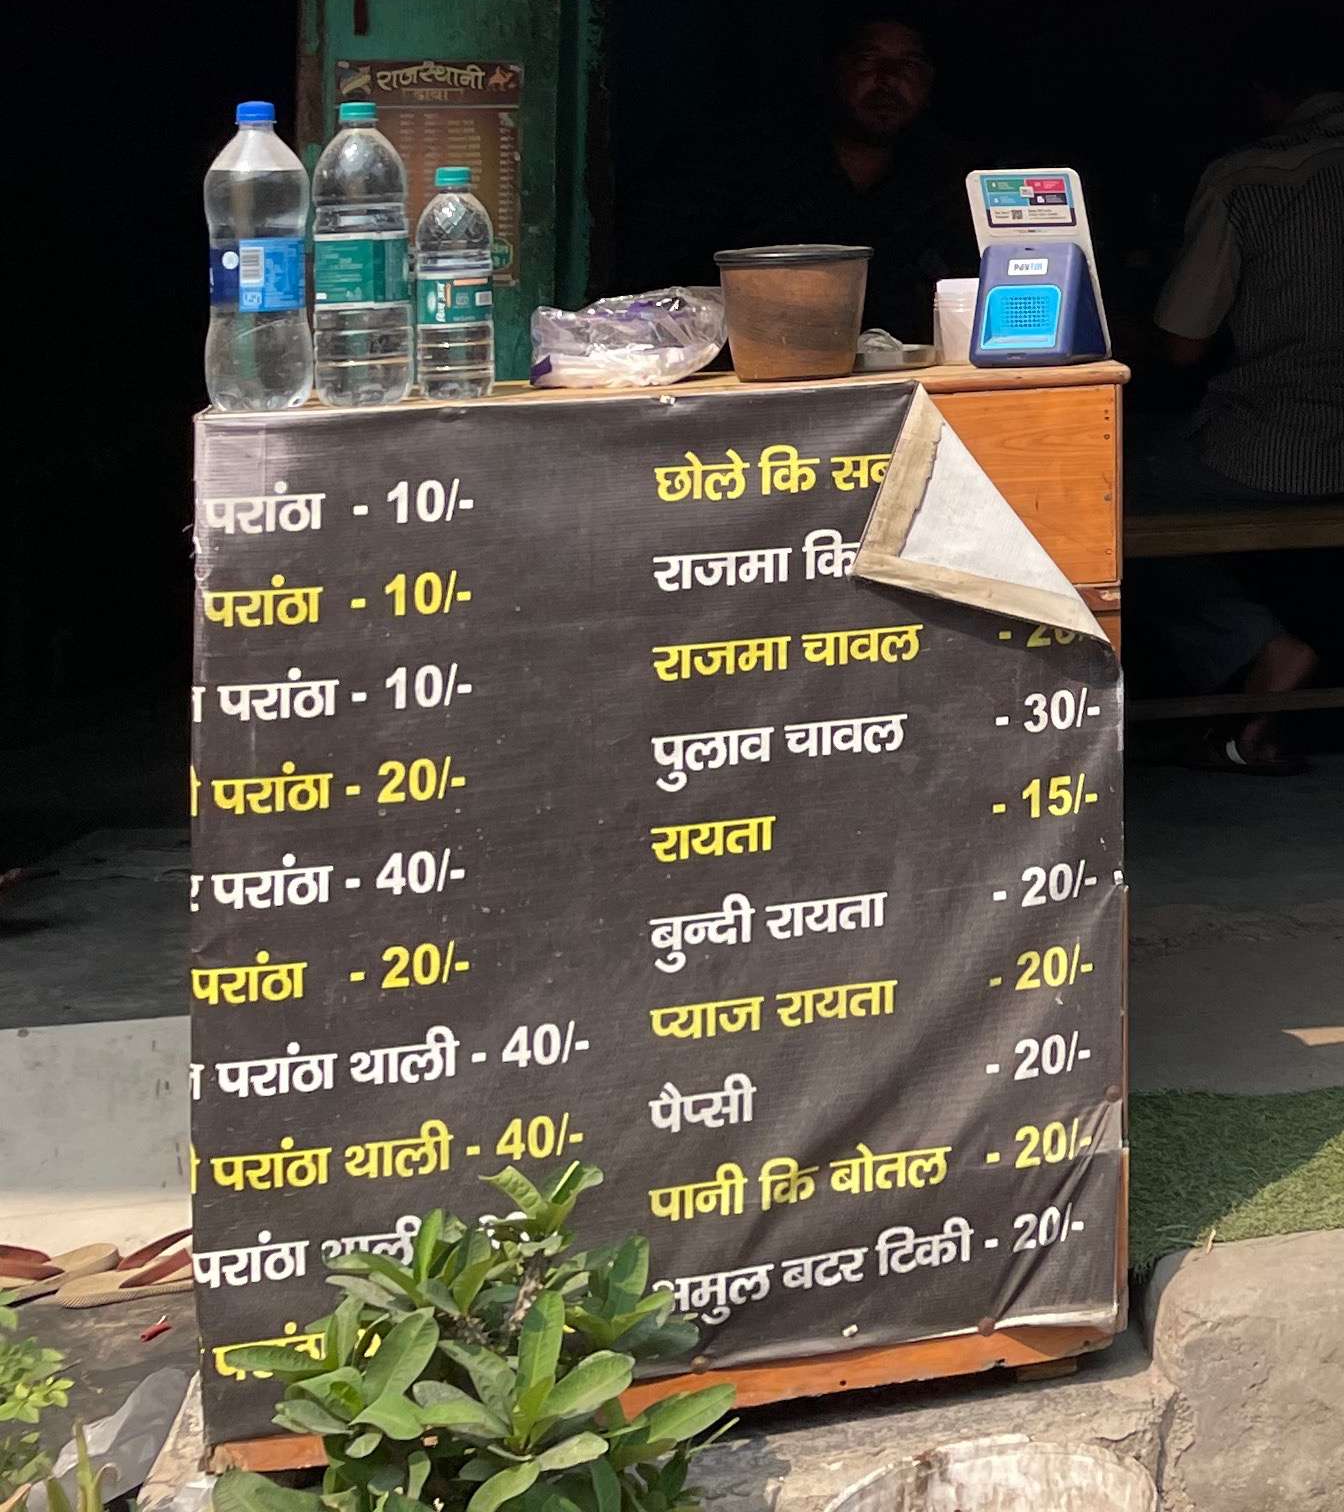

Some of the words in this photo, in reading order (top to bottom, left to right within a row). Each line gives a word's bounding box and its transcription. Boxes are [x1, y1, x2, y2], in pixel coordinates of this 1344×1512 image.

[376, 61, 486, 91] राजस्थानी
[655, 449, 749, 502] छोले
[758, 444, 820, 495] कि
[202, 480, 326, 535] परांठा
[386, 478, 474, 524] 10/-
[653, 547, 792, 592] राजमा
[803, 529, 861, 580] कि
[202, 574, 323, 628] परांठा
[385, 570, 472, 616] 10/-
[652, 636, 791, 682] राजमा
[802, 624, 923, 666] चावल
[217, 667, 339, 722] परांठा
[385, 663, 472, 710] 10/-
[651, 727, 774, 793] पुलाव
[785, 713, 908, 758] चावल
[1023, 688, 1101, 734] 30/-
[212, 761, 333, 815] परांठा
[376, 756, 466, 804] 20/-
[651, 816, 776, 863] रायता
[1021, 773, 1098, 819] 15/-
[212, 853, 334, 910] परांठा
[376, 848, 466, 895] 40/-
[650, 893, 754, 973] बुन्दी
[766, 892, 887, 940] रायता
[1021, 860, 1098, 907] 20/-
[191, 950, 307, 1005] परांठा
[381, 940, 471, 989] 20/-
[650, 996, 764, 1040] प्याज
[776, 980, 898, 1027] रायता
[1015, 937, 1094, 990] 20/-
[216, 1042, 337, 1098] परांठा
[350, 1025, 460, 1086] थाली
[502, 1020, 590, 1068] 40/-
[648, 1073, 756, 1133] पैप्सी
[1014, 1031, 1091, 1081] 20/-
[211, 1137, 332, 1192] परांठा
[344, 1119, 454, 1180] थाली
[496, 1113, 585, 1161] 40/-
[650, 1162, 747, 1221] पानी
[759, 1157, 820, 1212] कि
[830, 1143, 952, 1195] बोतल
[1015, 1118, 1092, 1169] 20/-
[192, 1230, 309, 1288] परांठा
[652, 1263, 774, 1326] अमुल
[782, 1246, 868, 1290] बटर
[876, 1217, 974, 1277] टिकी
[1012, 1203, 1085, 1253] 20/-
